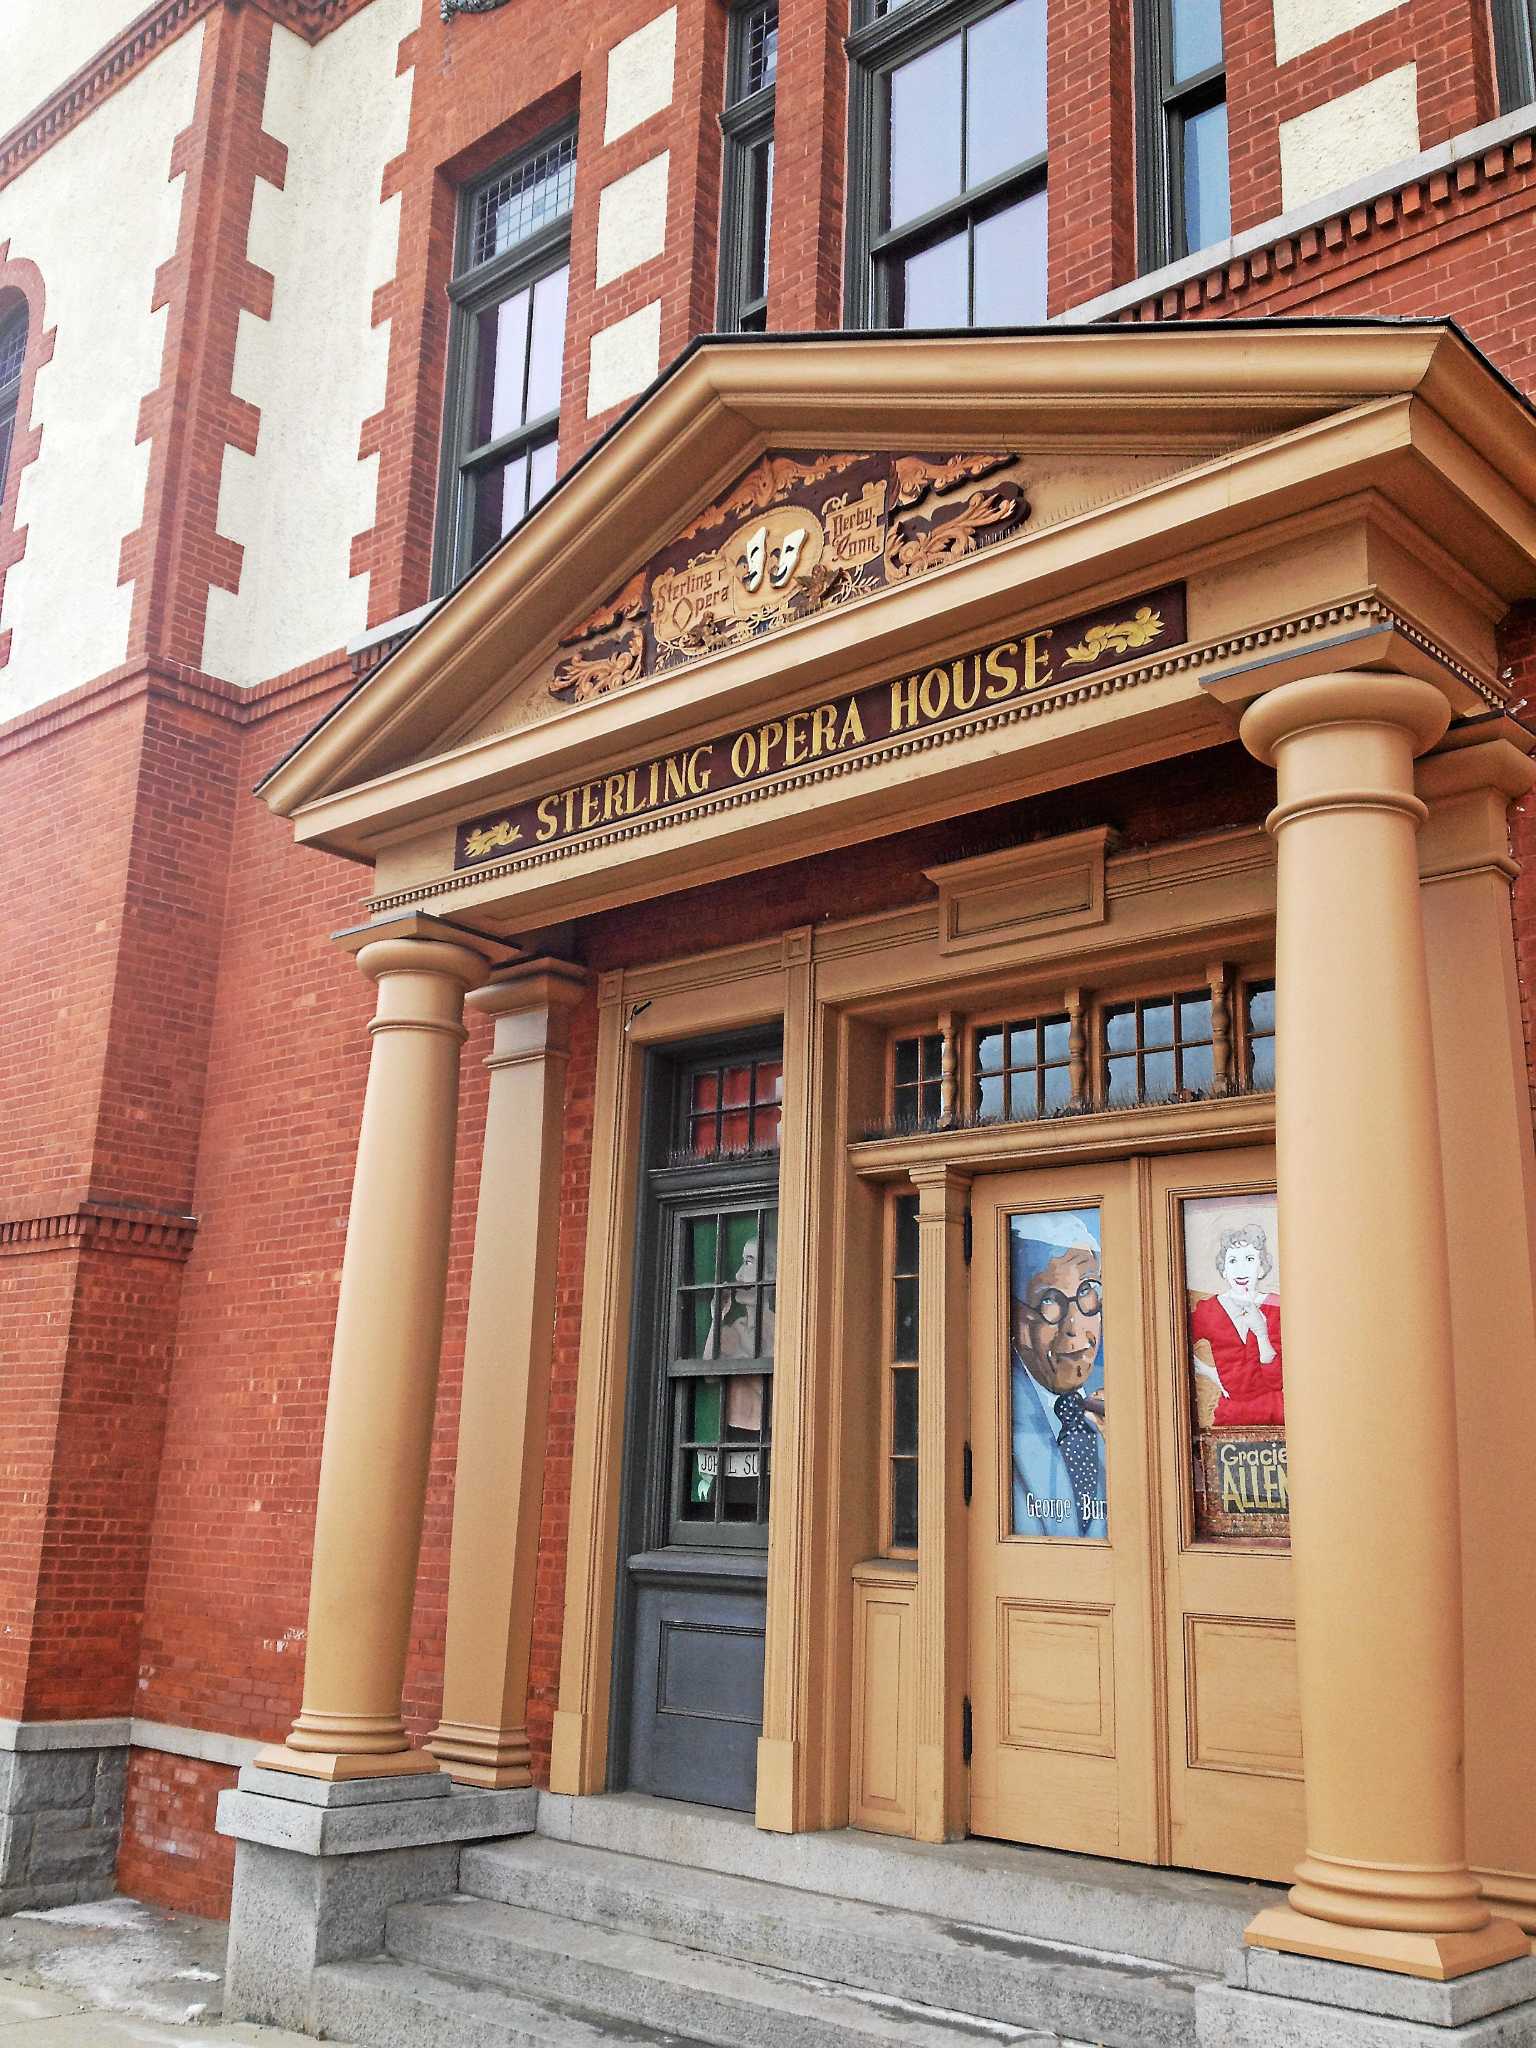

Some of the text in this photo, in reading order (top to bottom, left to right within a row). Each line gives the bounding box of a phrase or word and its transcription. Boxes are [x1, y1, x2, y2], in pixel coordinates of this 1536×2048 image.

[656, 571, 713, 617] Sterling
[672, 584, 730, 633] Opera
[535, 629, 1053, 842] STERLING OPERA HOUSE
[1220, 1443, 1287, 1466] Gracie
[1026, 1492, 1107, 1523] George Bur
